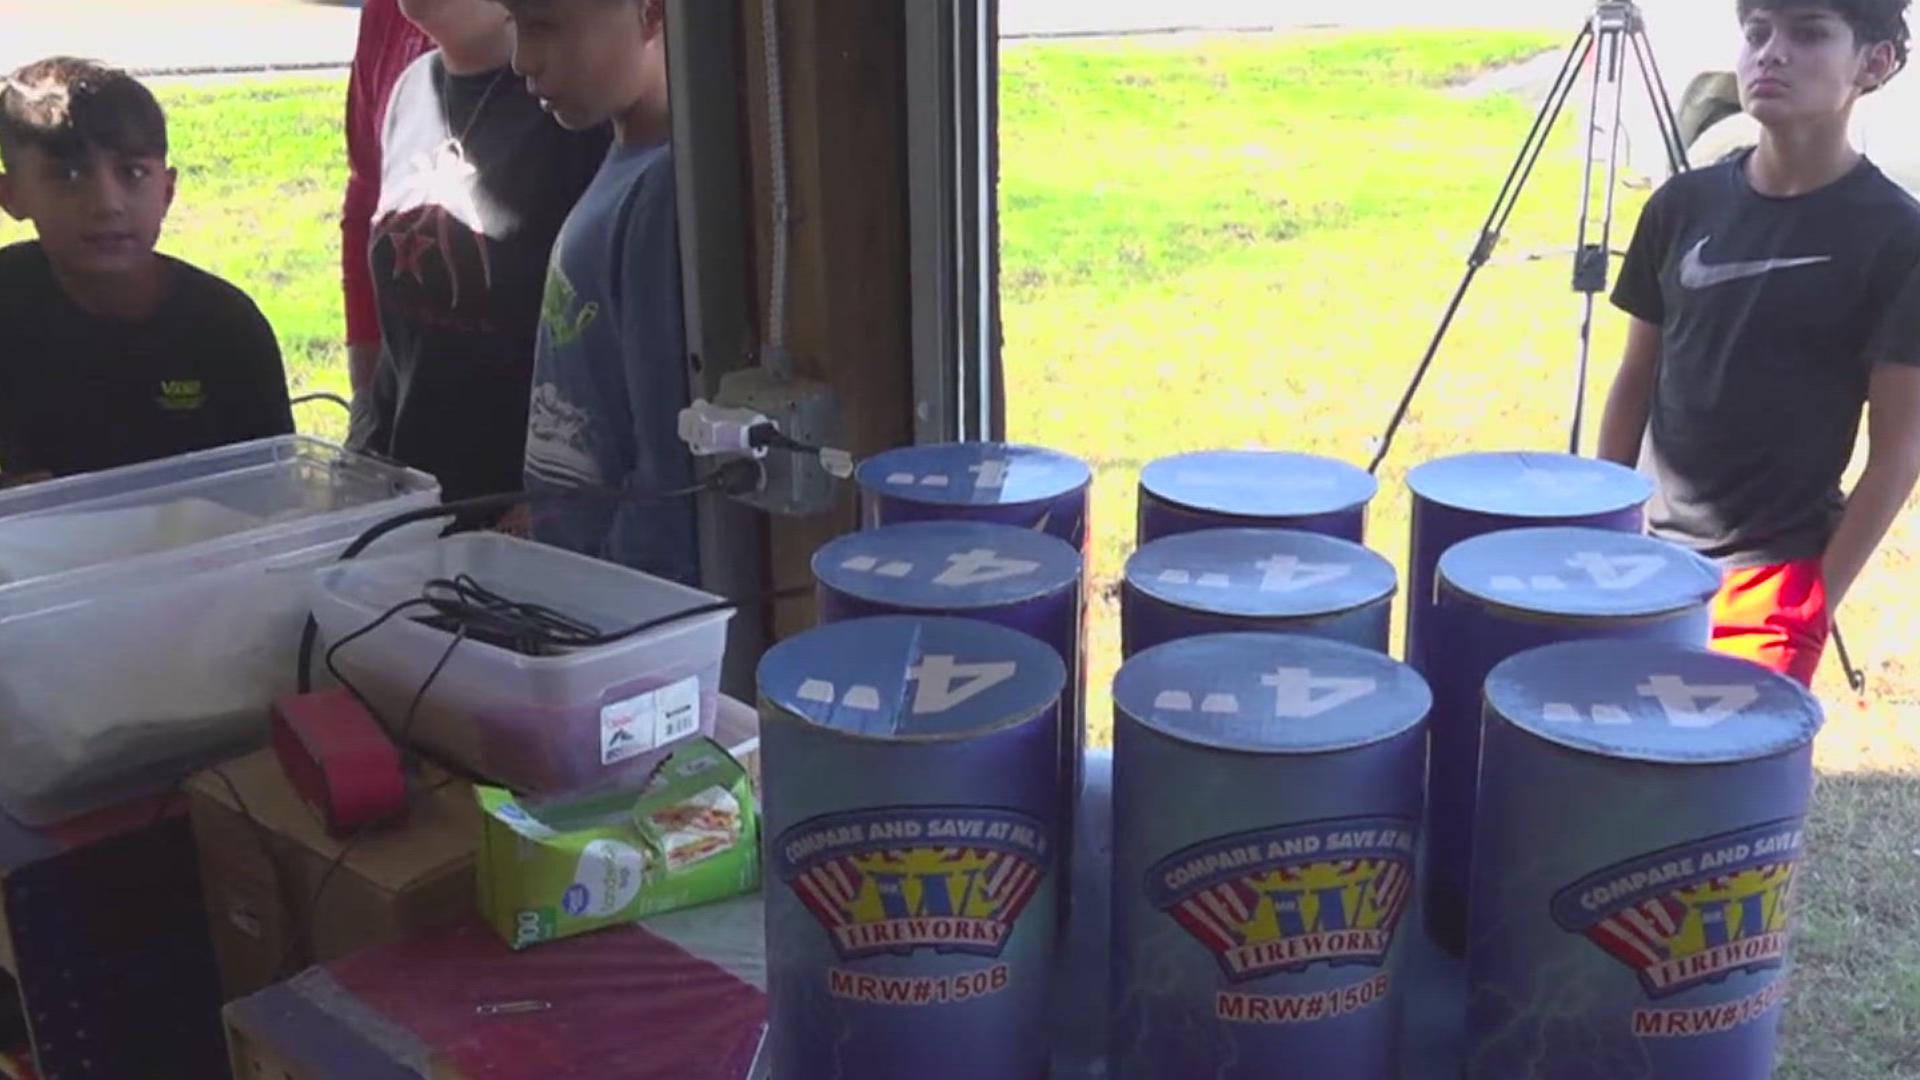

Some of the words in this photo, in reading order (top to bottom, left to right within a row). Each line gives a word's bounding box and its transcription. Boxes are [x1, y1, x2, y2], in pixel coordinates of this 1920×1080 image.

[786, 826, 864, 863] COMPARE
[868, 821, 922, 840] AND
[927, 820, 984, 838] SAVE
[985, 822, 1010, 840] AT
[1164, 846, 1262, 890] COMPARE
[1267, 835, 1321, 859] AND
[1326, 831, 1376, 850] SAVE
[1580, 857, 1695, 910] COMPARE
[1700, 844, 1749, 869] AND
[848, 919, 999, 945] FIREWORKS
[1237, 930, 1387, 969] FIREWORKS
[831, 965, 1007, 1001] MRW#150B
[1218, 975, 1389, 1020] MRW#150B
[1634, 984, 1780, 1034] MRW#150
